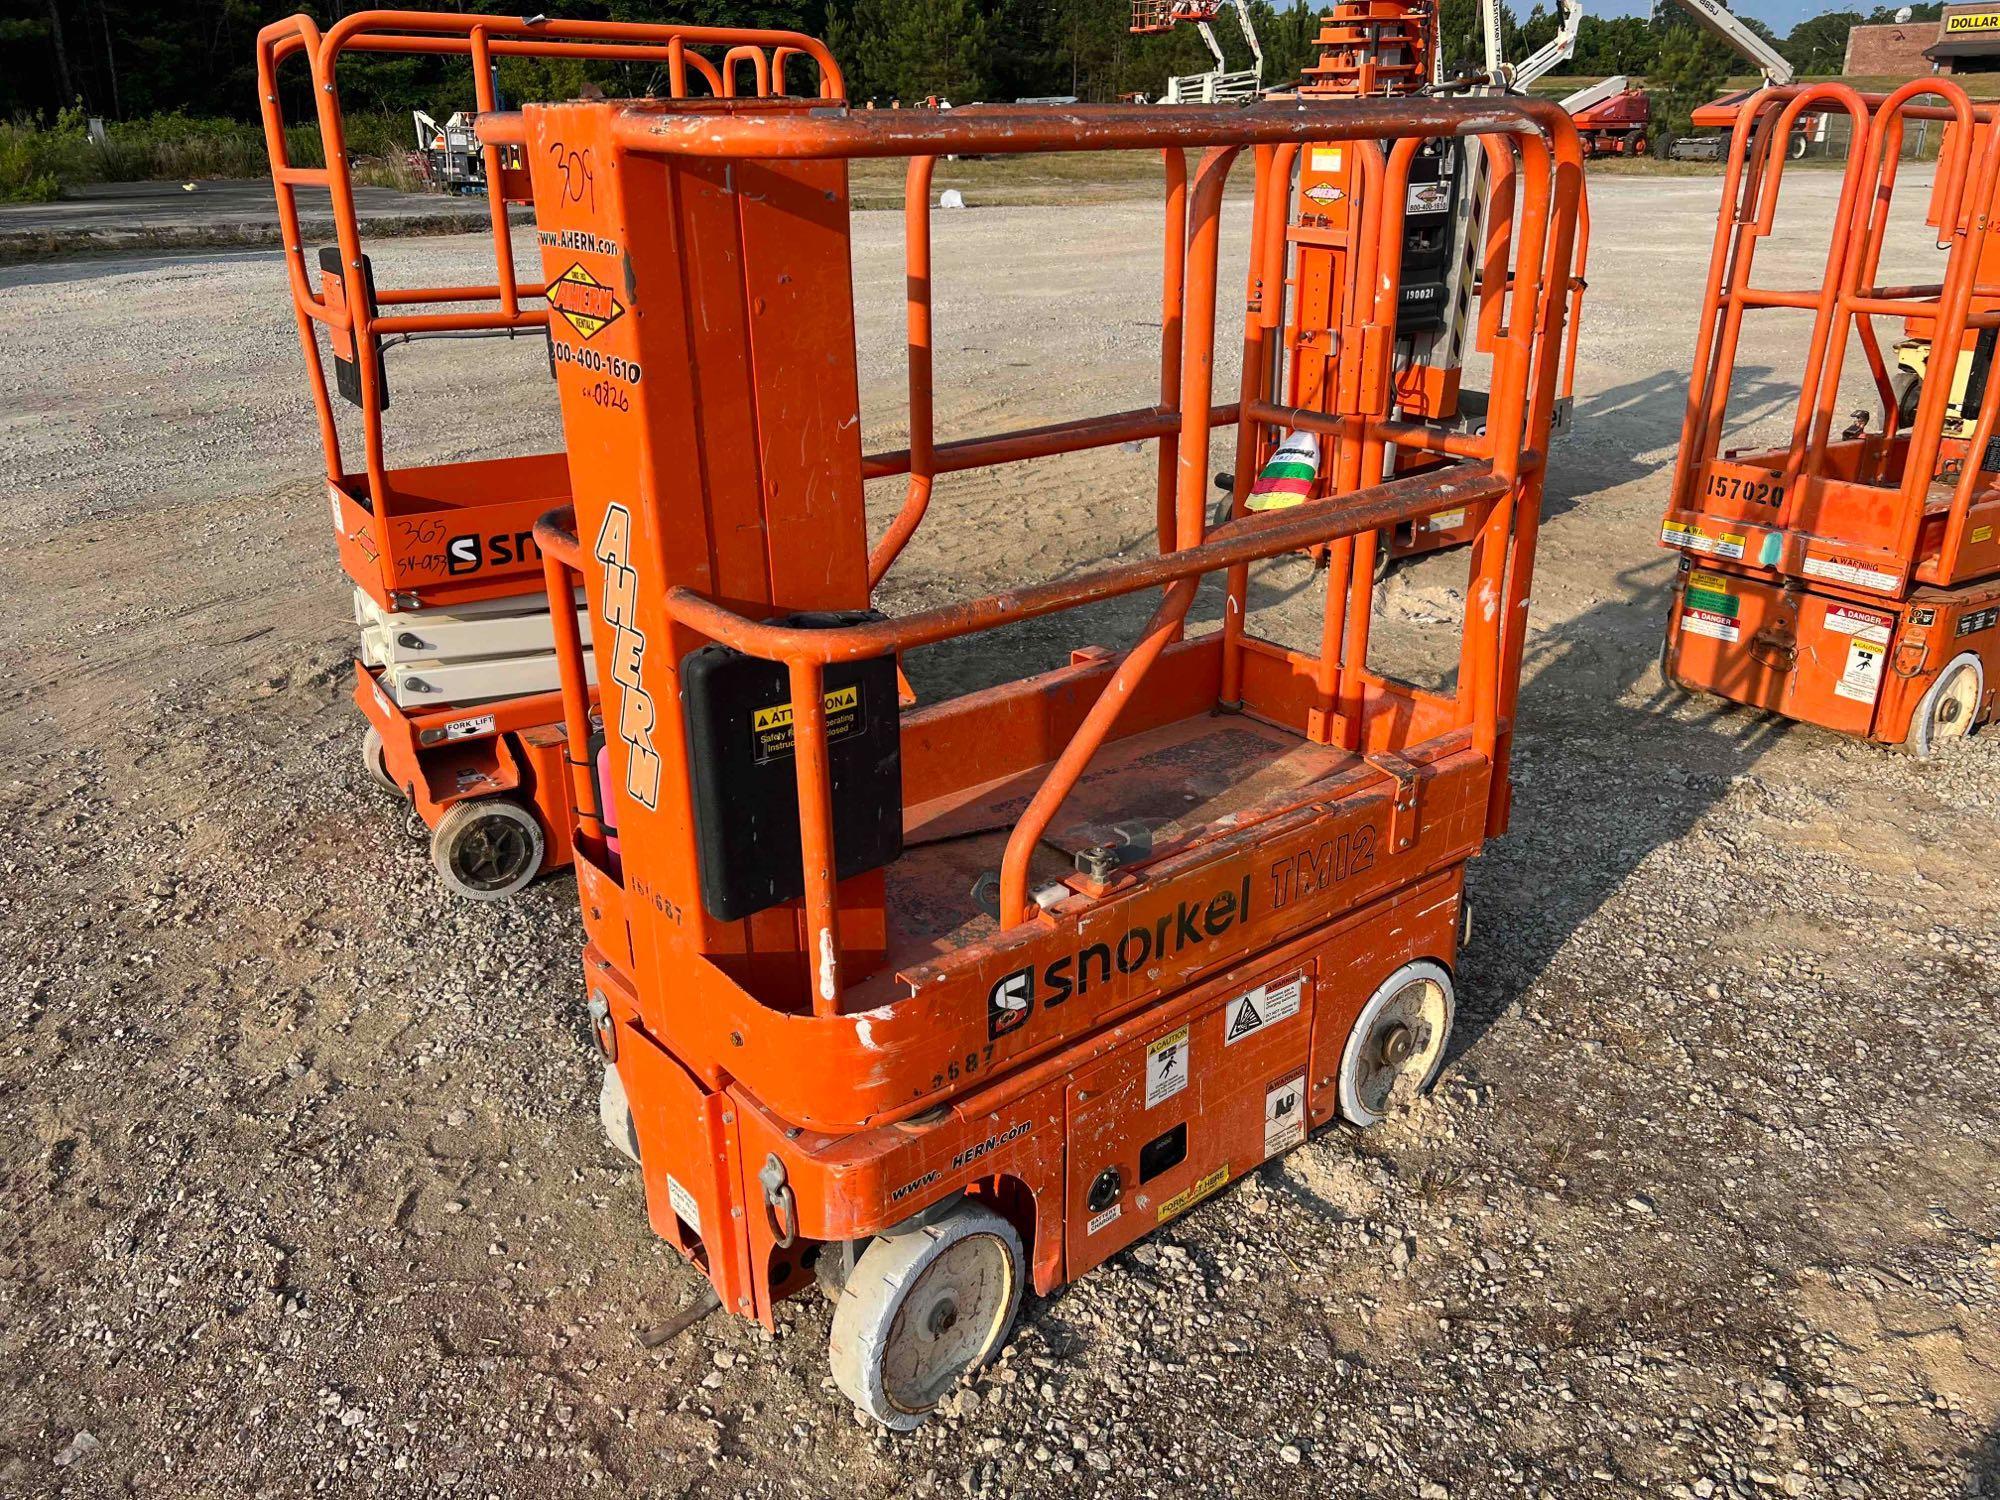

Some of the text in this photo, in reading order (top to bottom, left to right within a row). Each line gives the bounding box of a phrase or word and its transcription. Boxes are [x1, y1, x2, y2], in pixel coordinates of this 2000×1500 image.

[1951, 17, 1998, 28] DOLLAR
[550, 142, 595, 215] 309
[553, 280, 614, 319] AHERN
[1406, 288, 1434, 300] 190021
[575, 317, 595, 331] RENTALS
[1707, 475, 1784, 508] 157020
[397, 519, 447, 550] 365
[1701, 612, 1731, 625] DANGER
[1847, 610, 1882, 624] DANGER
[596, 502, 661, 812] AHERN
[1857, 642, 1883, 654] CAUTION
[448, 716, 494, 731] FORK LIFT
[760, 731, 786, 744] Safety
[1043, 875, 1250, 1009] snorkel
[1156, 1027, 1187, 1051] CAUTION
[1204, 1171, 1225, 1188] HERE
[1090, 1206, 1117, 1226] BATTERY
[1090, 1212, 1117, 1232] CHARGER
